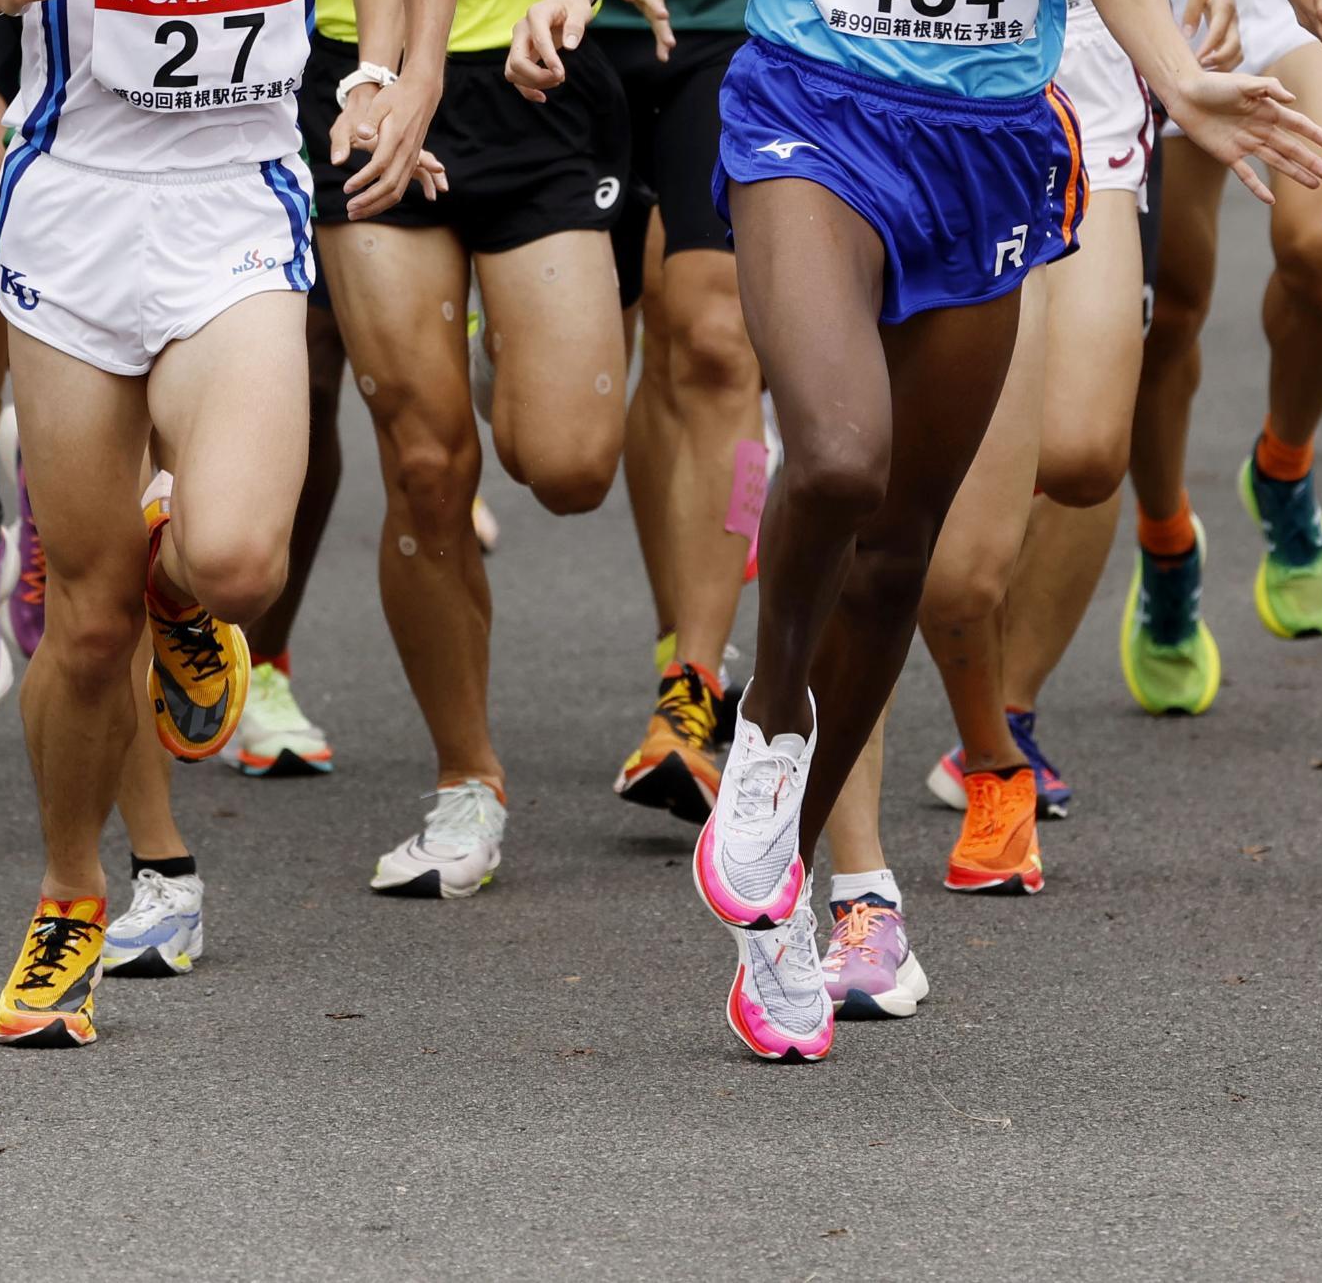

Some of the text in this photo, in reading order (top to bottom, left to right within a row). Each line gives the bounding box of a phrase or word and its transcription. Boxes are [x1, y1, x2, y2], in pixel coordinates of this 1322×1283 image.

[828, 8, 1023, 42] 第99回箱根駅伝予選会
[152, 12, 266, 88] 27
[0, 264, 41, 311] KU
